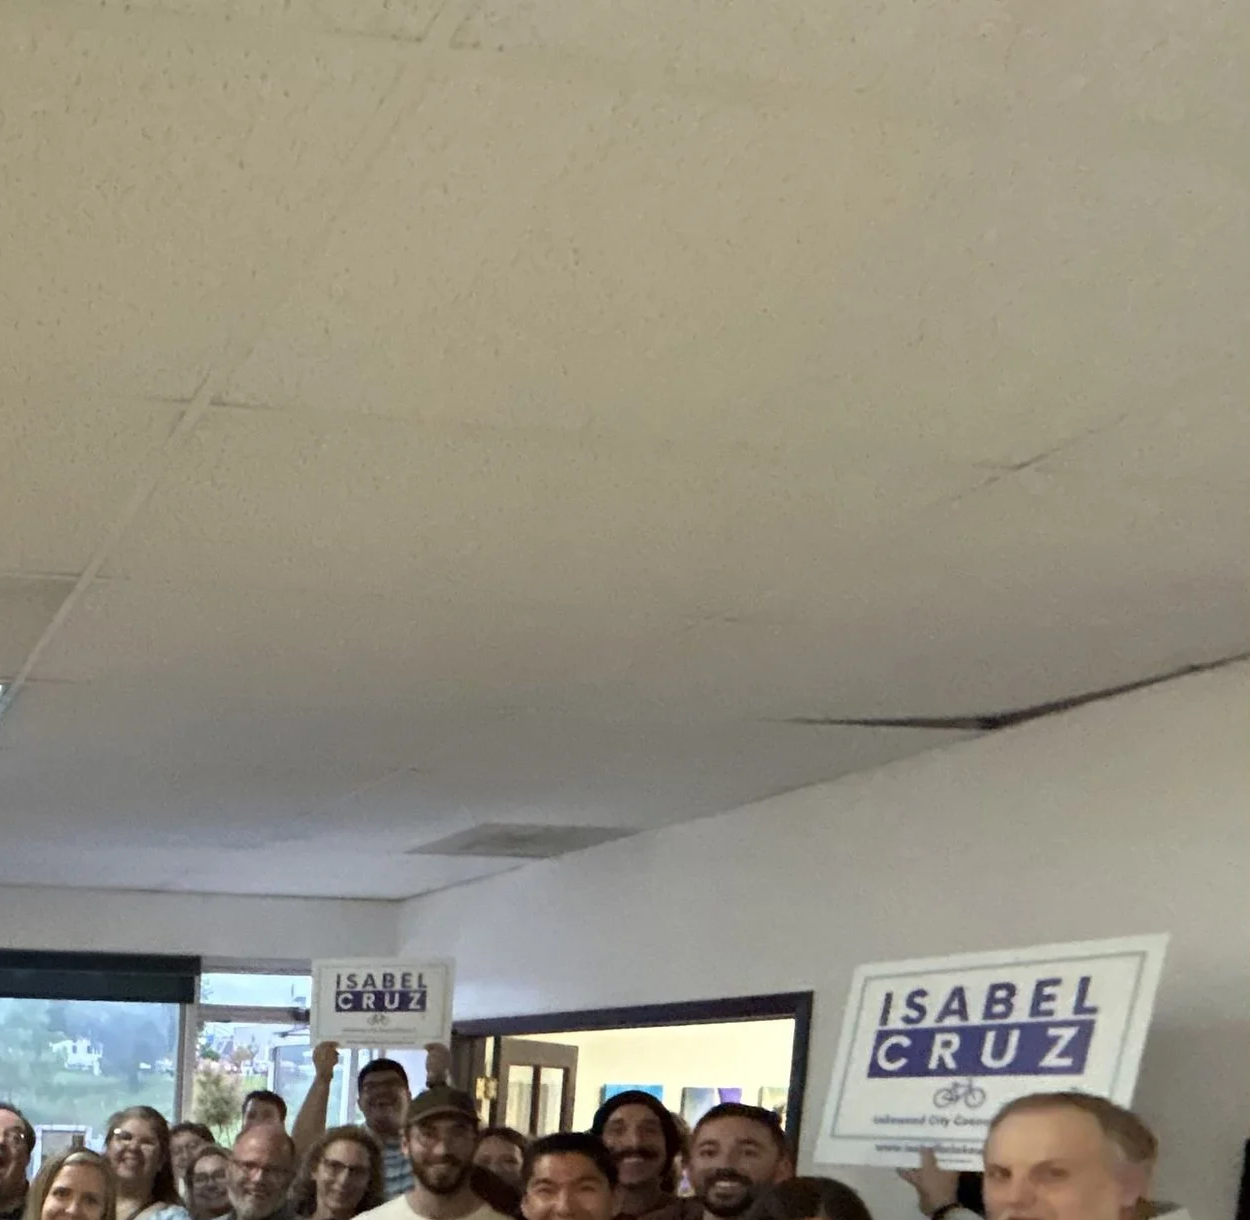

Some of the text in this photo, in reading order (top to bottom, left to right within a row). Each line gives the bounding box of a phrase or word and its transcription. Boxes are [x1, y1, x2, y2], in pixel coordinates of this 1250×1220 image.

[336, 973, 427, 989] ISABEL
[338, 993, 420, 1009] CRUZ
[879, 976, 1098, 1026] ISABEL
[877, 1026, 1080, 1071] CRUZ
